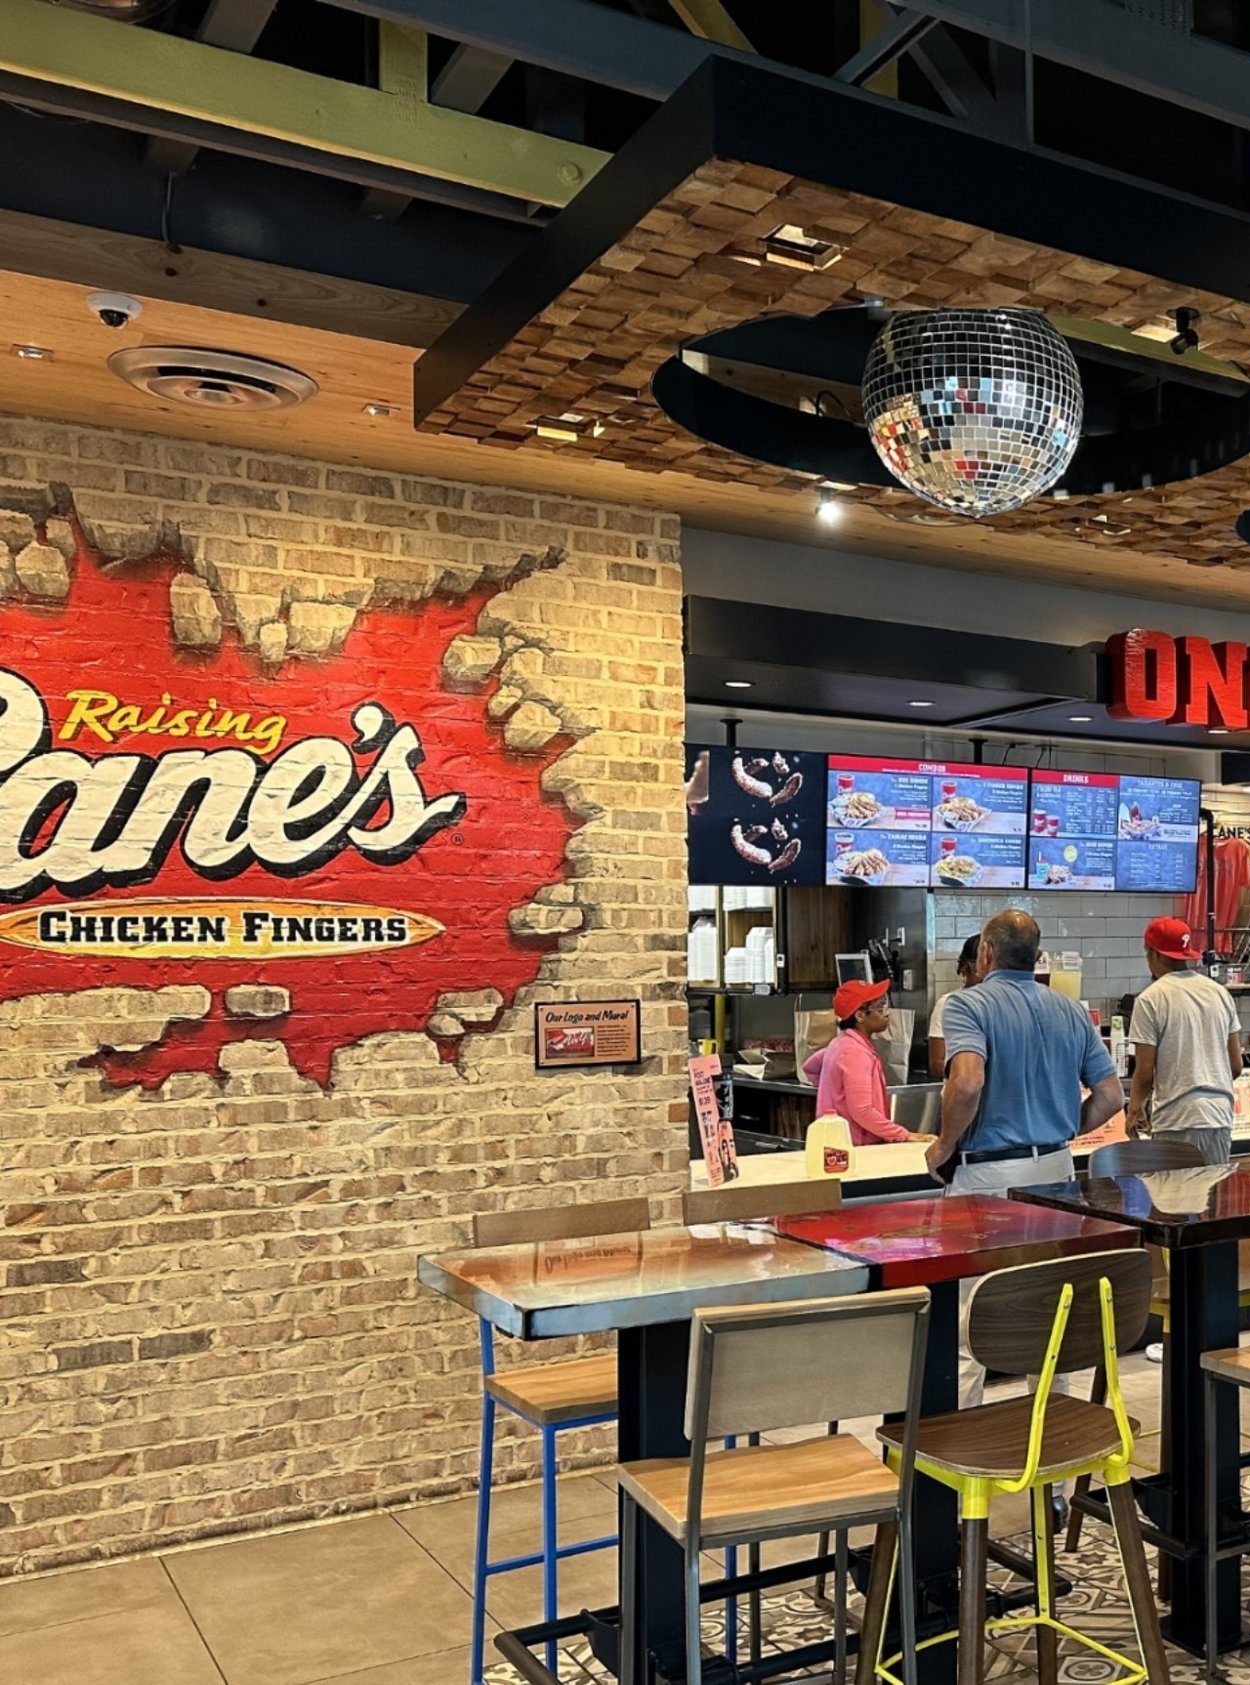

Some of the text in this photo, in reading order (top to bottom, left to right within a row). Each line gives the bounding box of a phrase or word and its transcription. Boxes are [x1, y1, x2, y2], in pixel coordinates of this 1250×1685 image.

[58, 690, 287, 754] Raising
[39, 910, 408, 943] CHICKEN FINGERS
[546, 1010, 628, 1024] Our Logo and Mural
